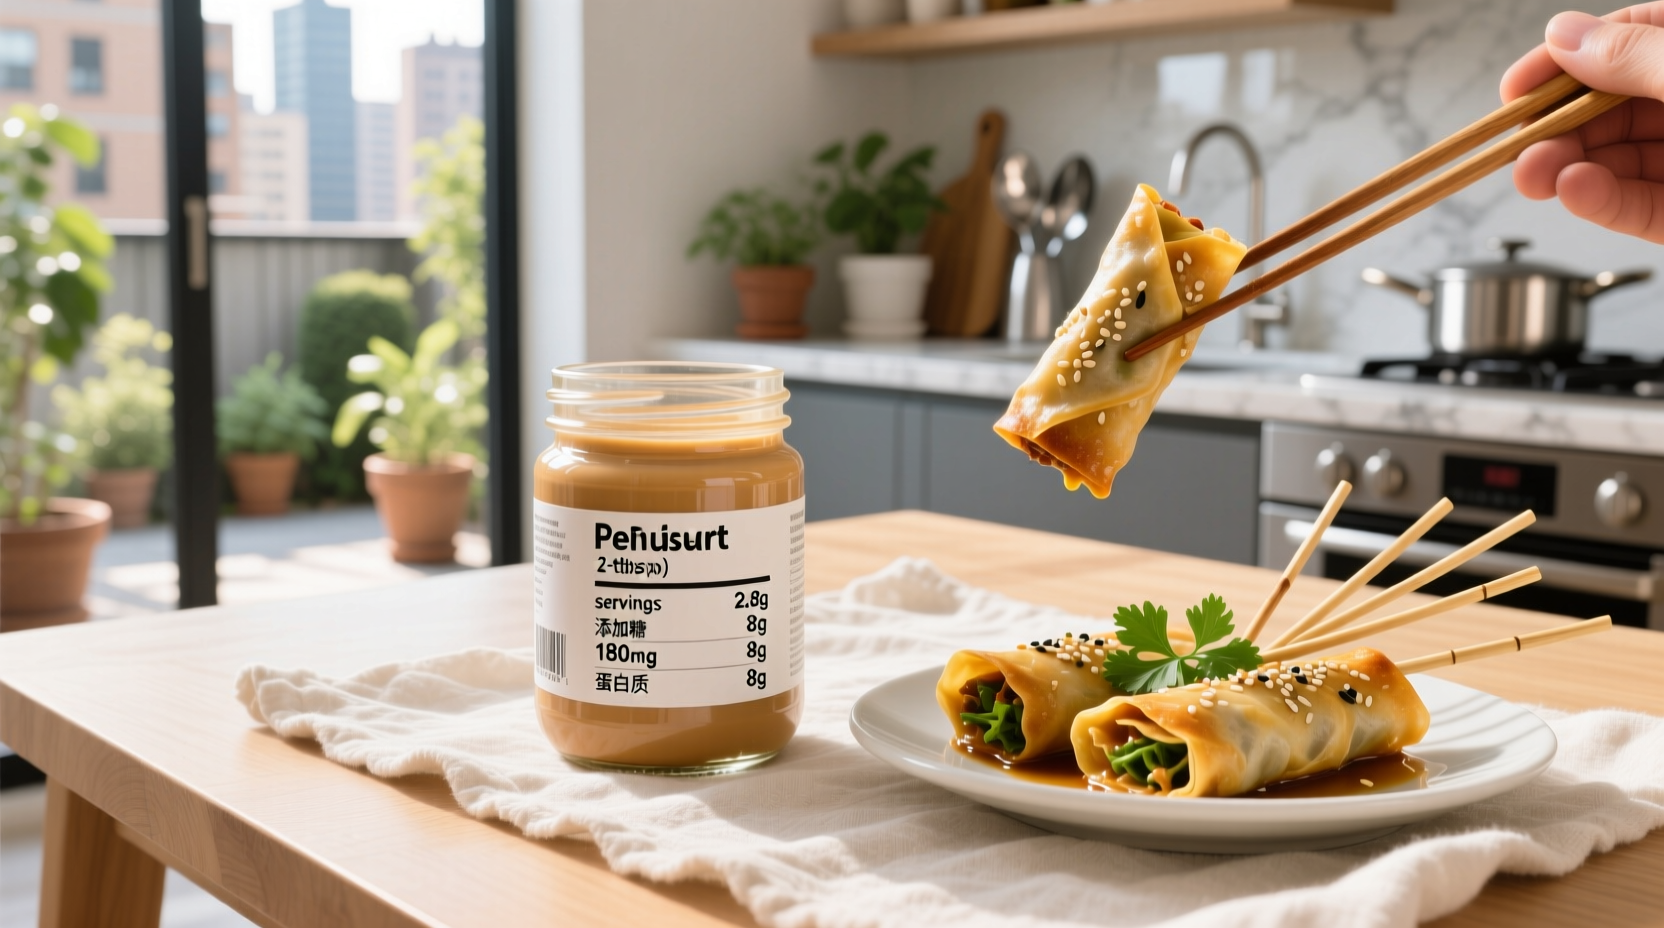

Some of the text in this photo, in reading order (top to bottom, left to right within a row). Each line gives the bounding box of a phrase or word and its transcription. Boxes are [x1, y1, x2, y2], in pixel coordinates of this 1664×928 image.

[595, 590, 769, 615] servings 2.8g
[594, 616, 647, 639] 添加糖
[746, 614, 767, 636] 8g
[595, 640, 767, 669] 180mg 8g
[595, 672, 649, 694] 蛋白质
[746, 668, 767, 690] 8g
